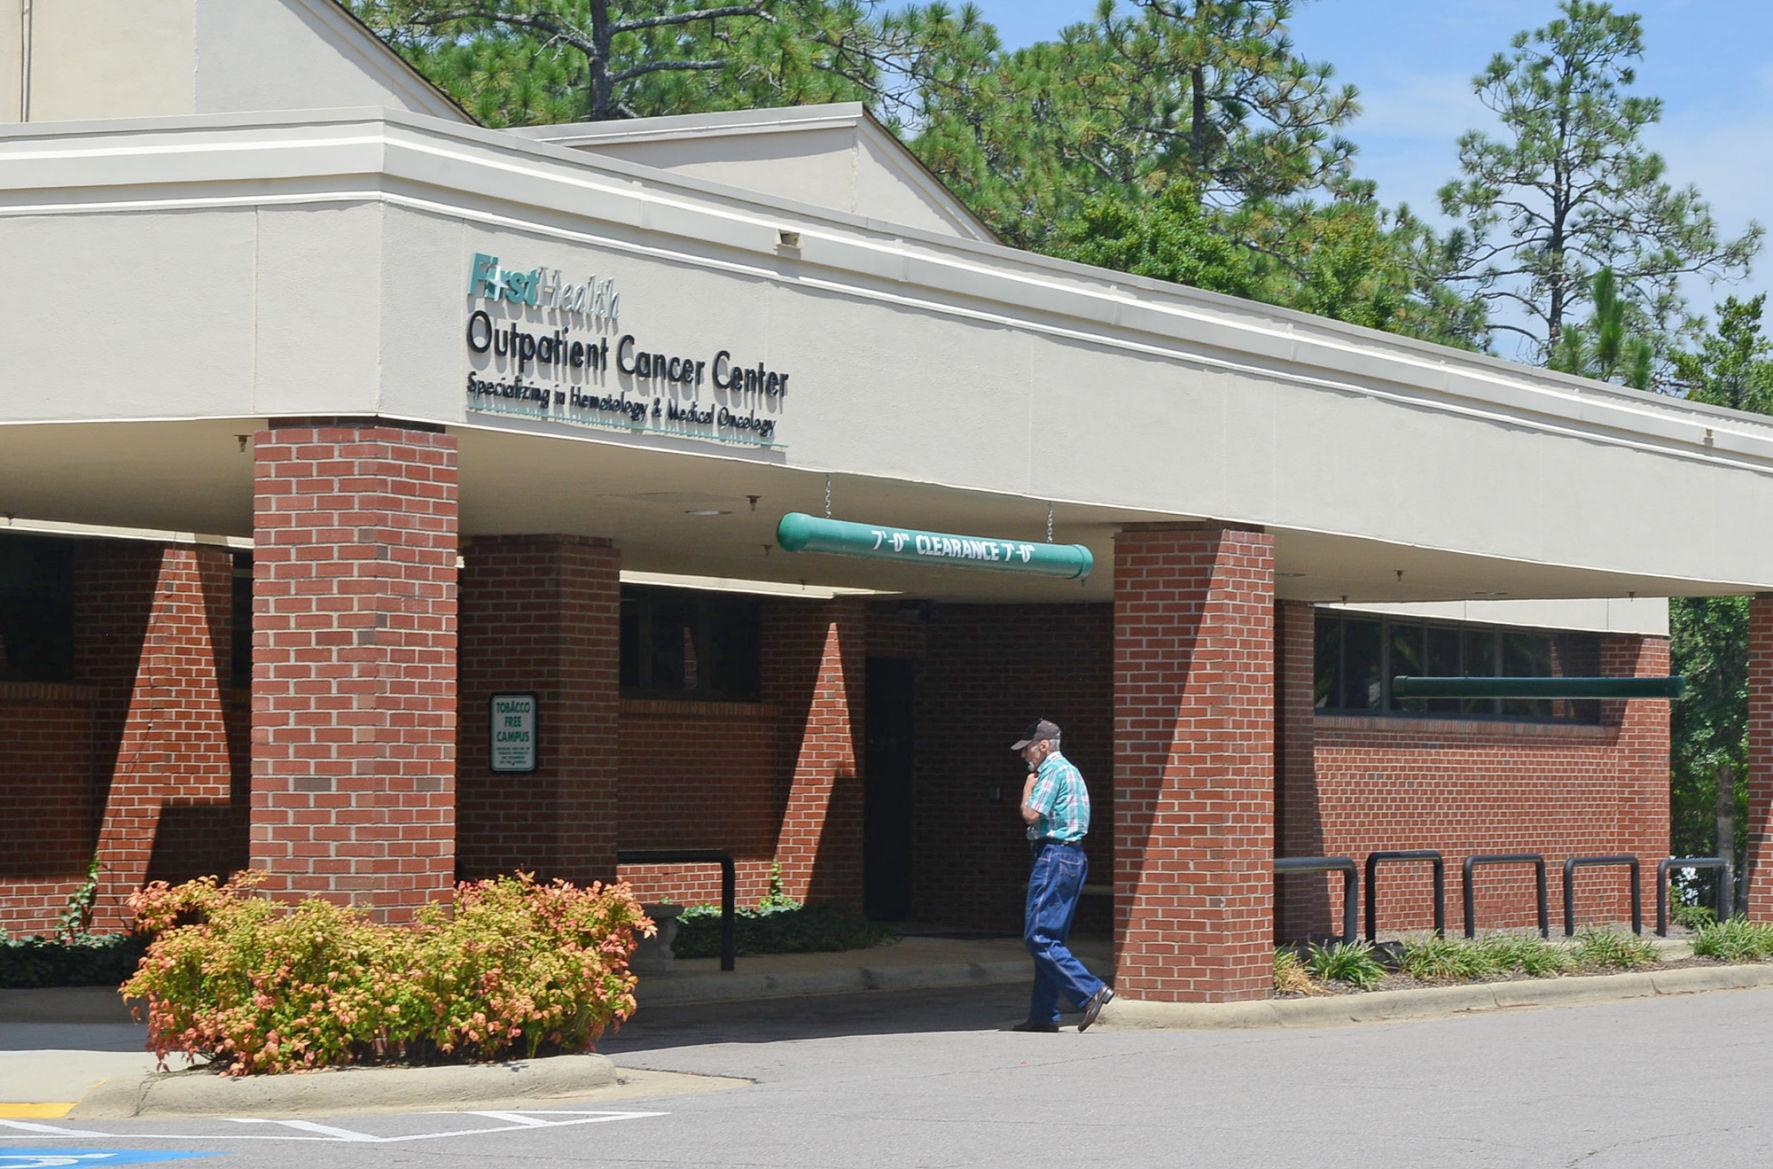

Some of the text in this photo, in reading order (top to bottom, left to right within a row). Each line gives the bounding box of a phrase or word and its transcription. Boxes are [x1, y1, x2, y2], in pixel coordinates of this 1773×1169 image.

[466, 309, 790, 398] Outpatient Cancer Center
[467, 371, 776, 437] Specializing in Hematology & Medical Oncology
[916, 535, 999, 561] CLEARANCE
[496, 702, 530, 713] TOBACCO
[505, 716, 522, 727] FREE
[497, 731, 529, 742] CAMPUS
